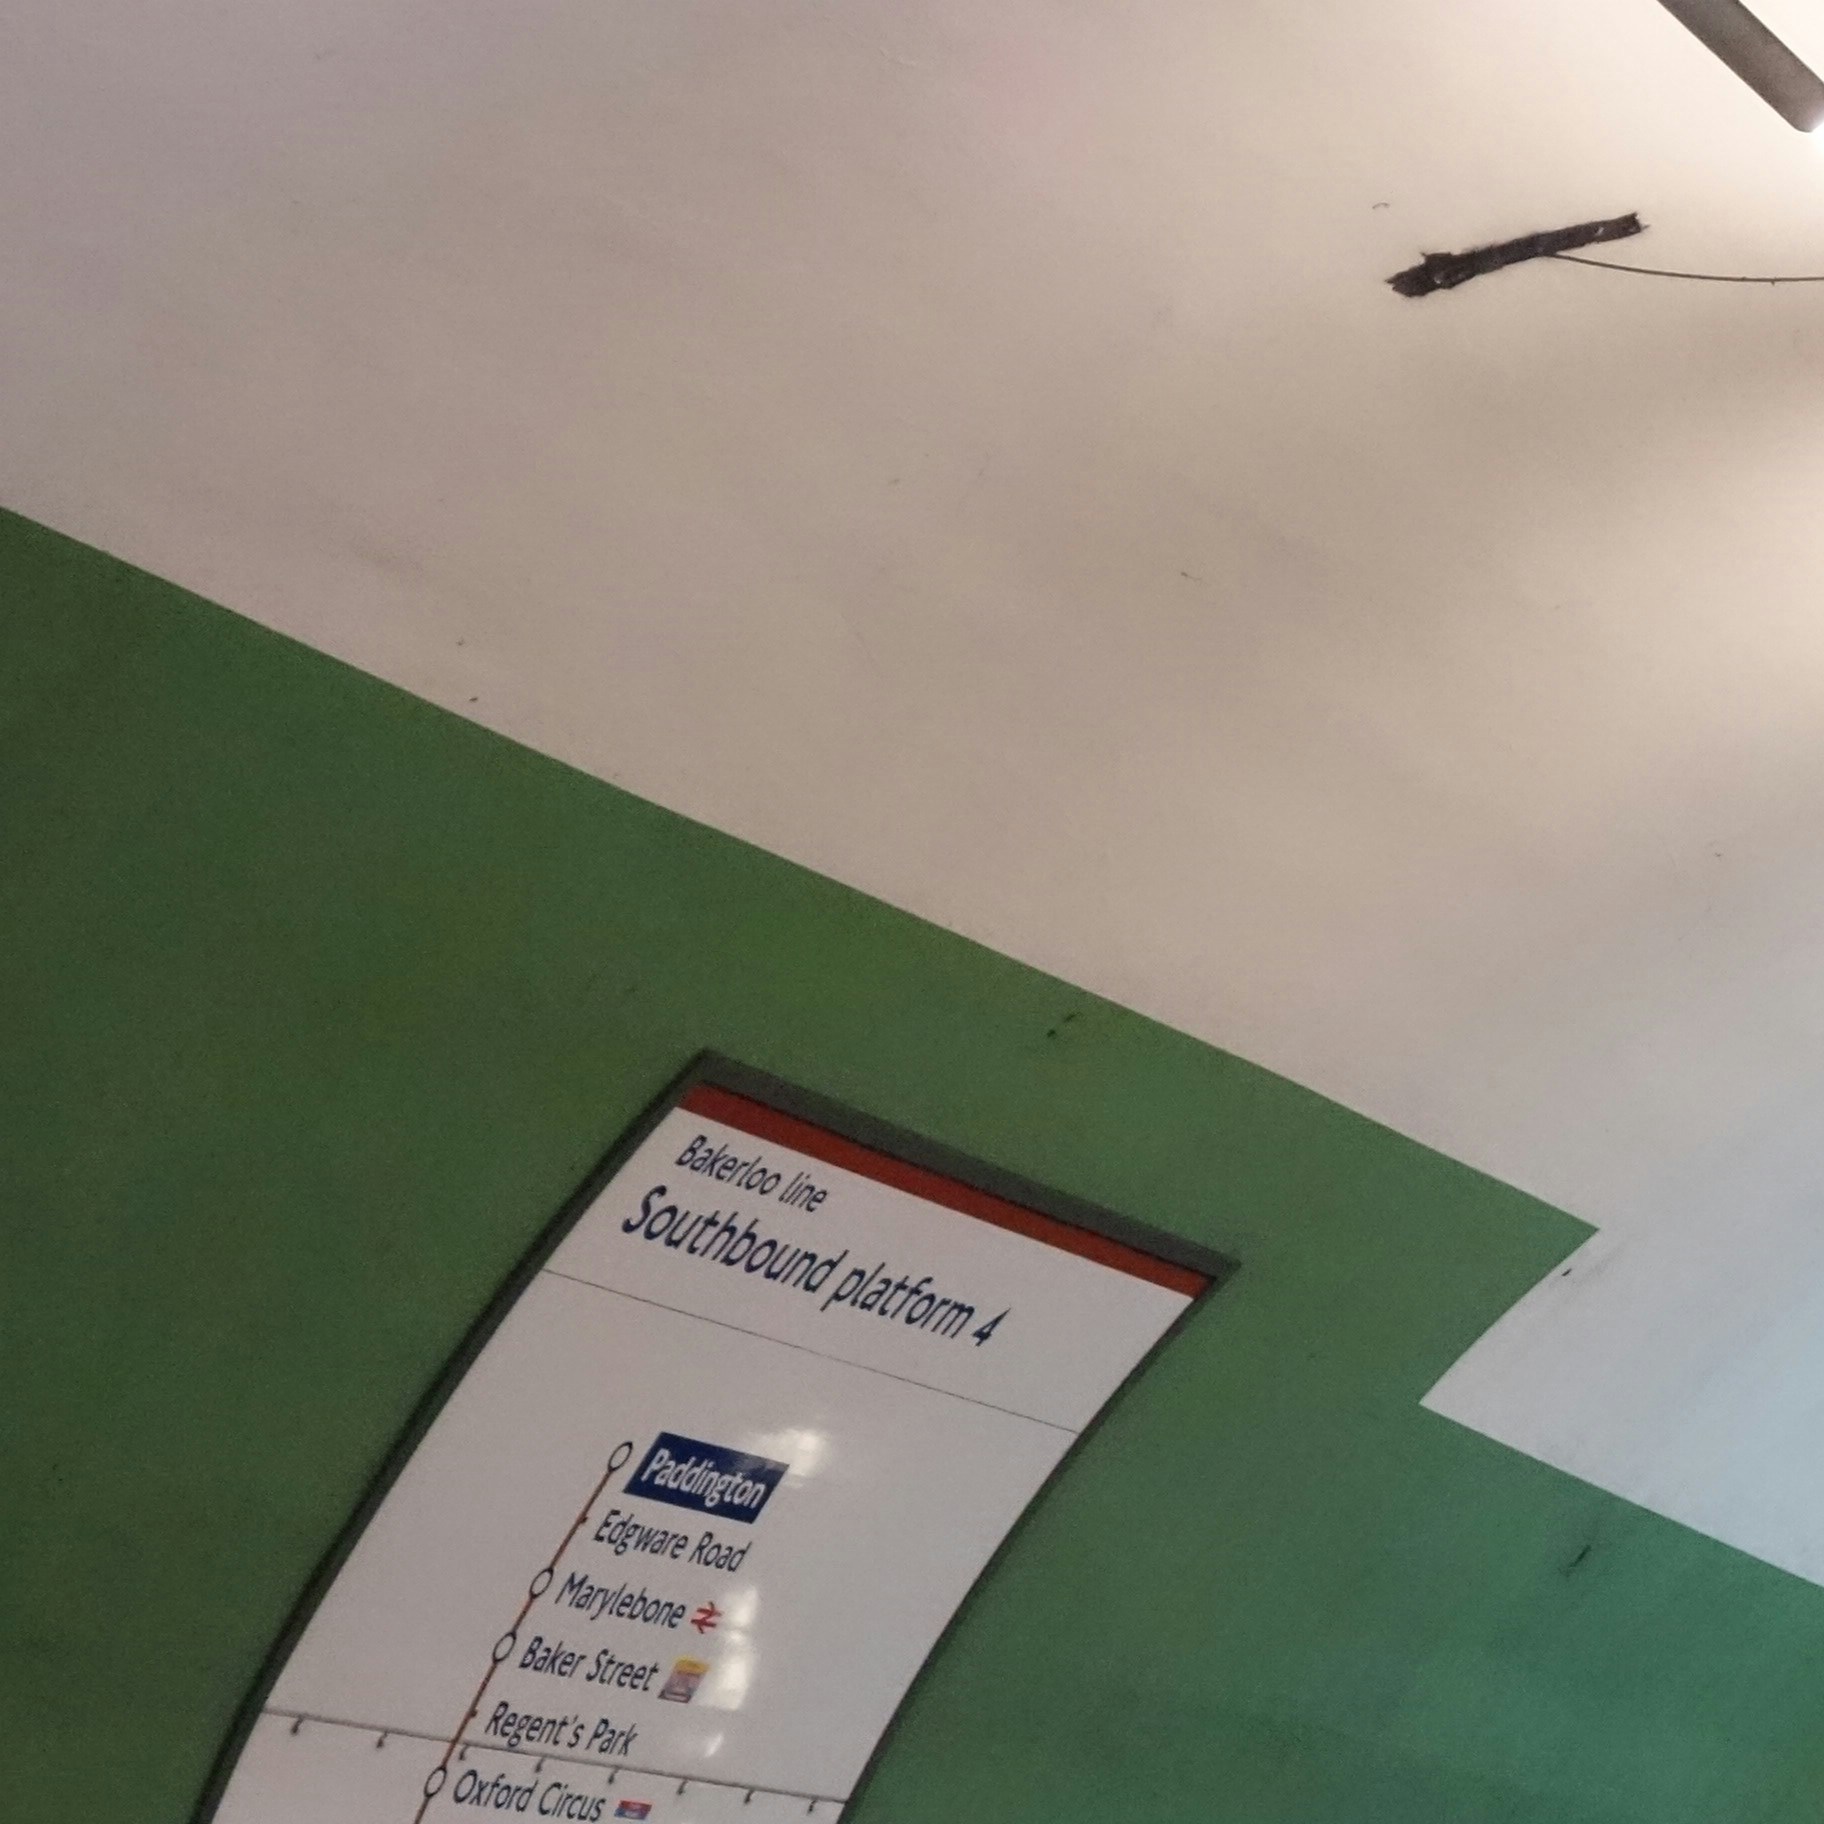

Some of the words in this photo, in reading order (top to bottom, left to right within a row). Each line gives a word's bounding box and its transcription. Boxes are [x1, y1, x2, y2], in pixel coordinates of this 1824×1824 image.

[675, 1134, 782, 1196] Bakerloo
[779, 1171, 828, 1212] line
[622, 1185, 849, 1293] Southbound
[819, 1262, 975, 1339] platform
[971, 1307, 1011, 1347] 4
[641, 1448, 766, 1509] Paddington
[592, 1509, 688, 1557] Edgware
[688, 1531, 752, 1573] Road
[555, 1572, 687, 1629] Marylebone
[518, 1635, 587, 1680] Baker
[585, 1649, 659, 1692] Street
[485, 1701, 585, 1748] Regent's
[586, 1718, 639, 1756] Park
[452, 1769, 537, 1813] Oxford
[536, 1782, 606, 1824] Circus
